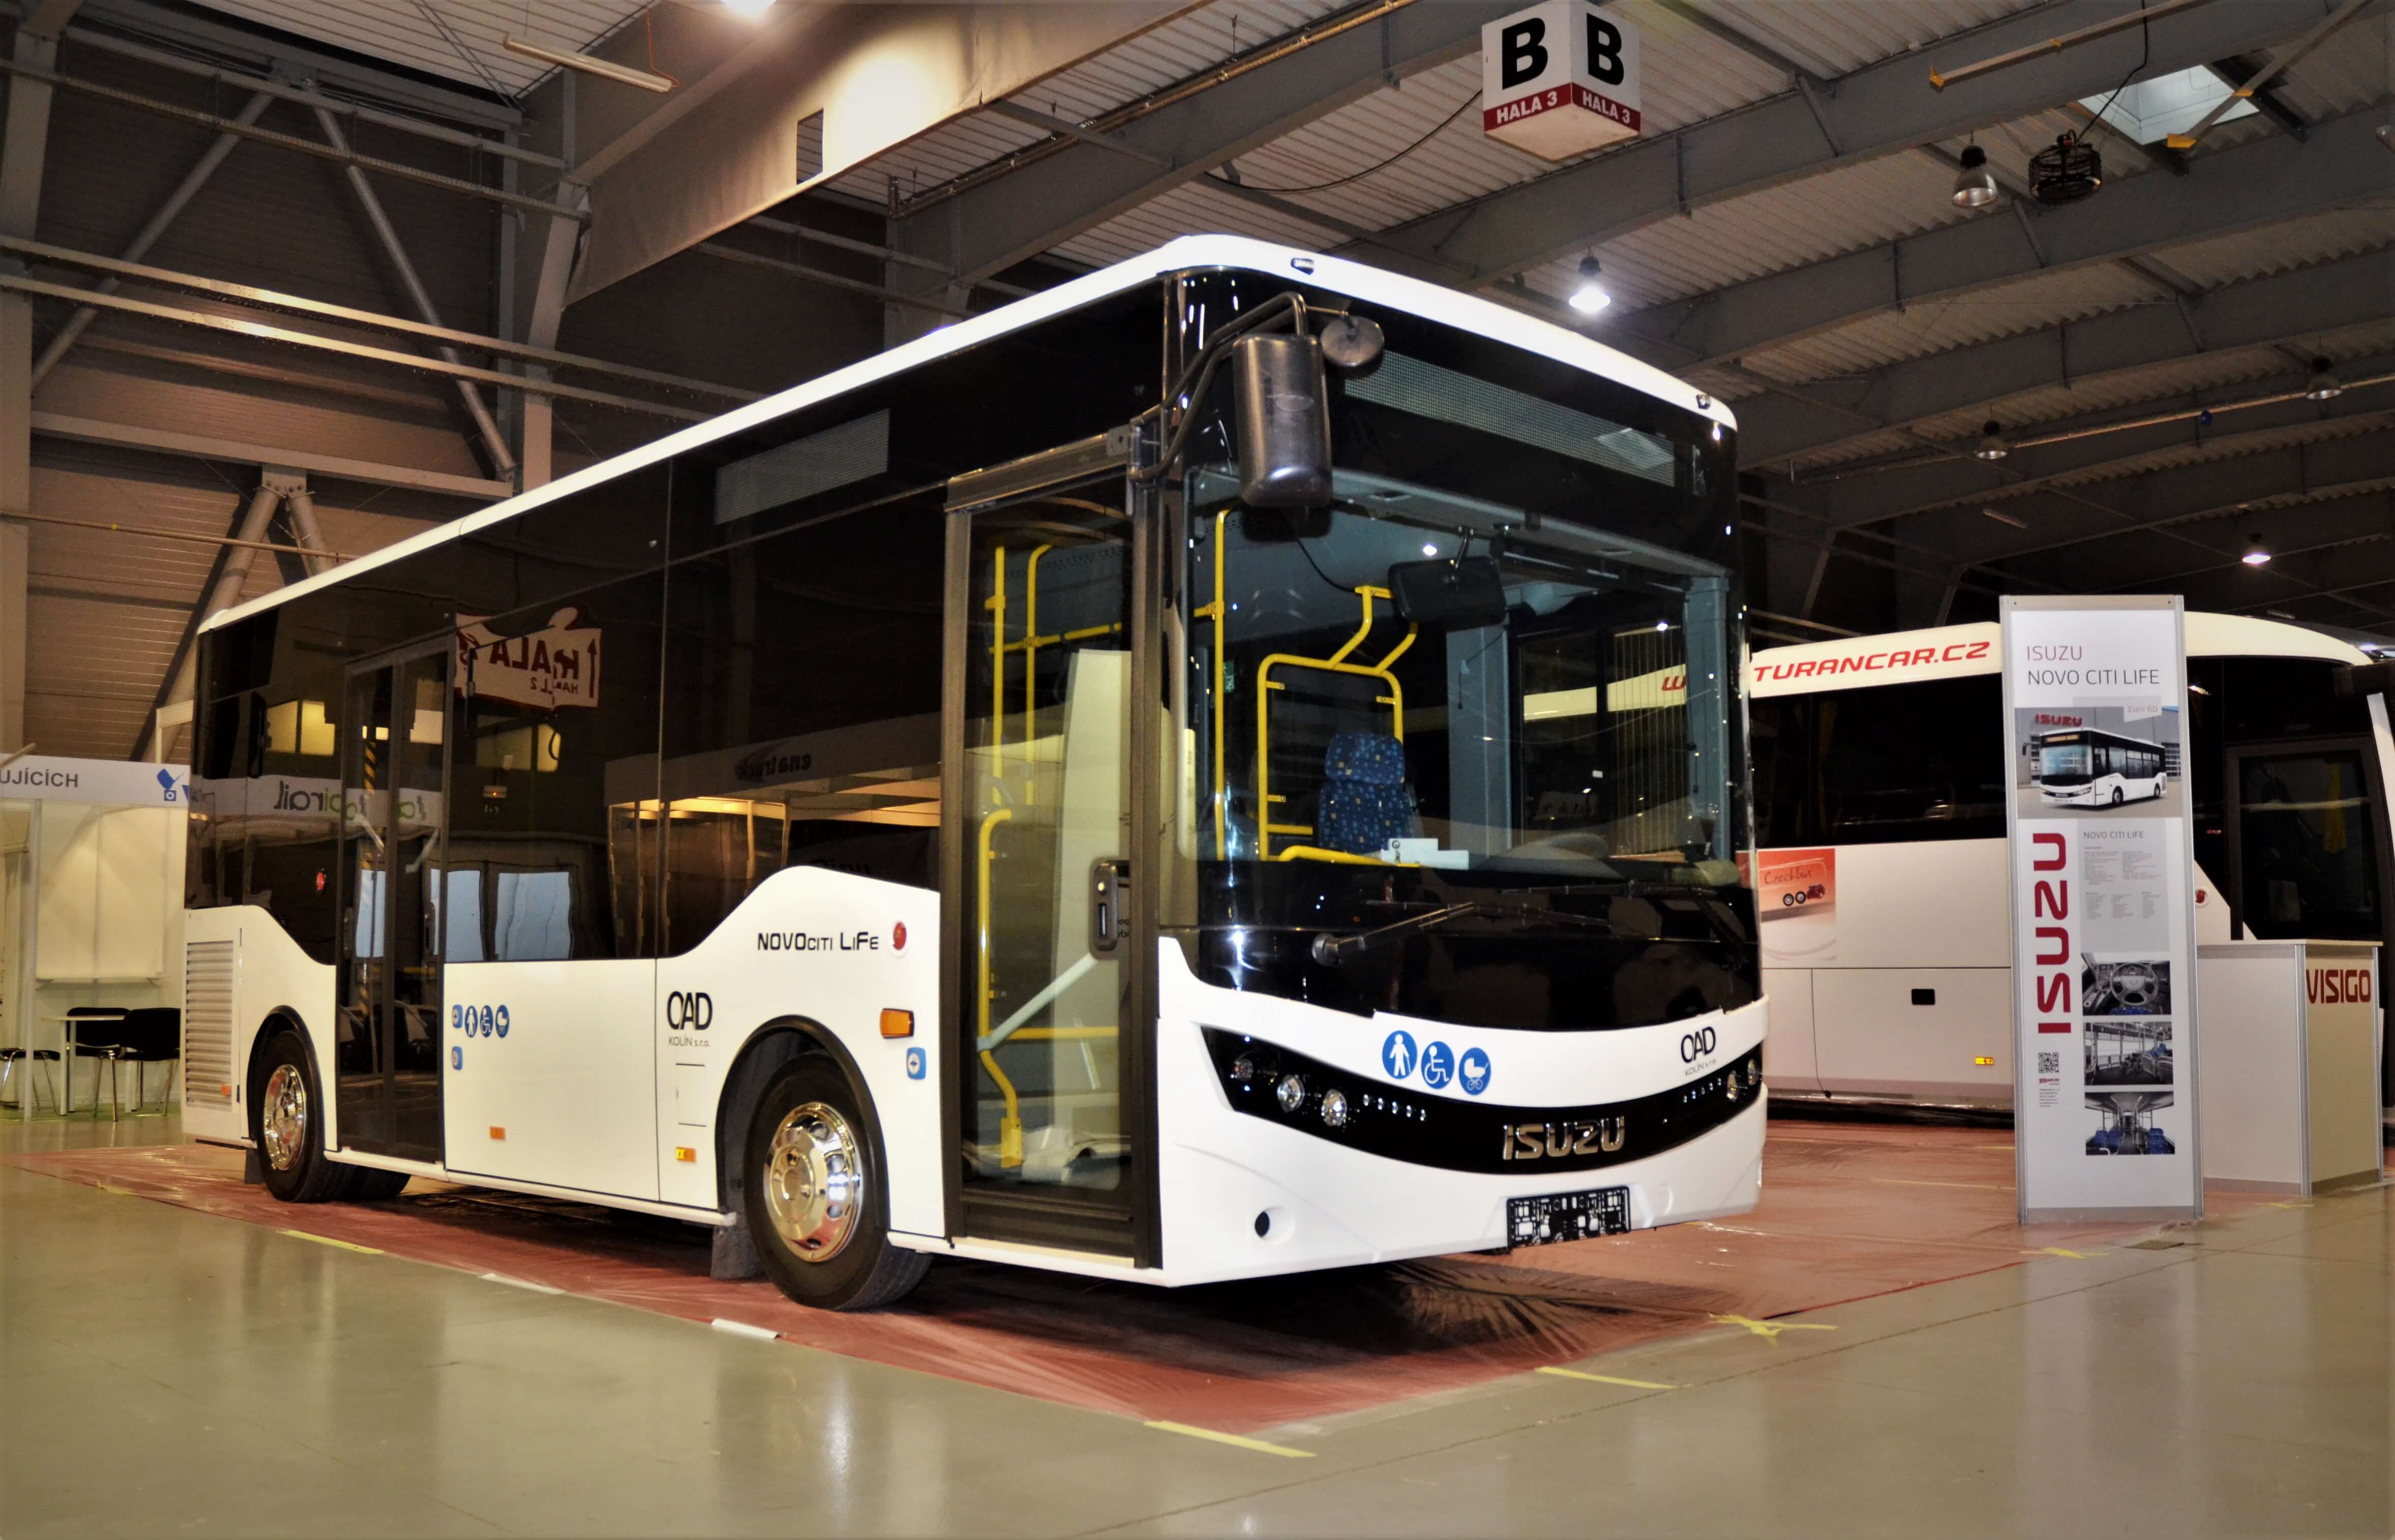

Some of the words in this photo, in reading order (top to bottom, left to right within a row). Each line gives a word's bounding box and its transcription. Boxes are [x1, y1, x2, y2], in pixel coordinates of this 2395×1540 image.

[1502, 17, 1548, 90] B
[1586, 12, 1624, 85] B
[1496, 97, 1542, 124] HALA
[1547, 90, 1558, 106] 3
[1582, 90, 1618, 119] HALA
[1622, 109, 1630, 124] 3
[1753, 641, 1990, 681] TURANCAR.CZ
[2027, 645, 2082, 660] ISUZU
[2028, 670, 2079, 685] NOVO
[2086, 670, 2117, 684] CITI
[2123, 669, 2160, 684] LIFE
[2035, 714, 2083, 727] ISUZU
[2032, 832, 2071, 1034] ISUZU
[2306, 970, 2372, 1004] VISIGO
[1503, 1116, 1625, 1160] ISUZU
